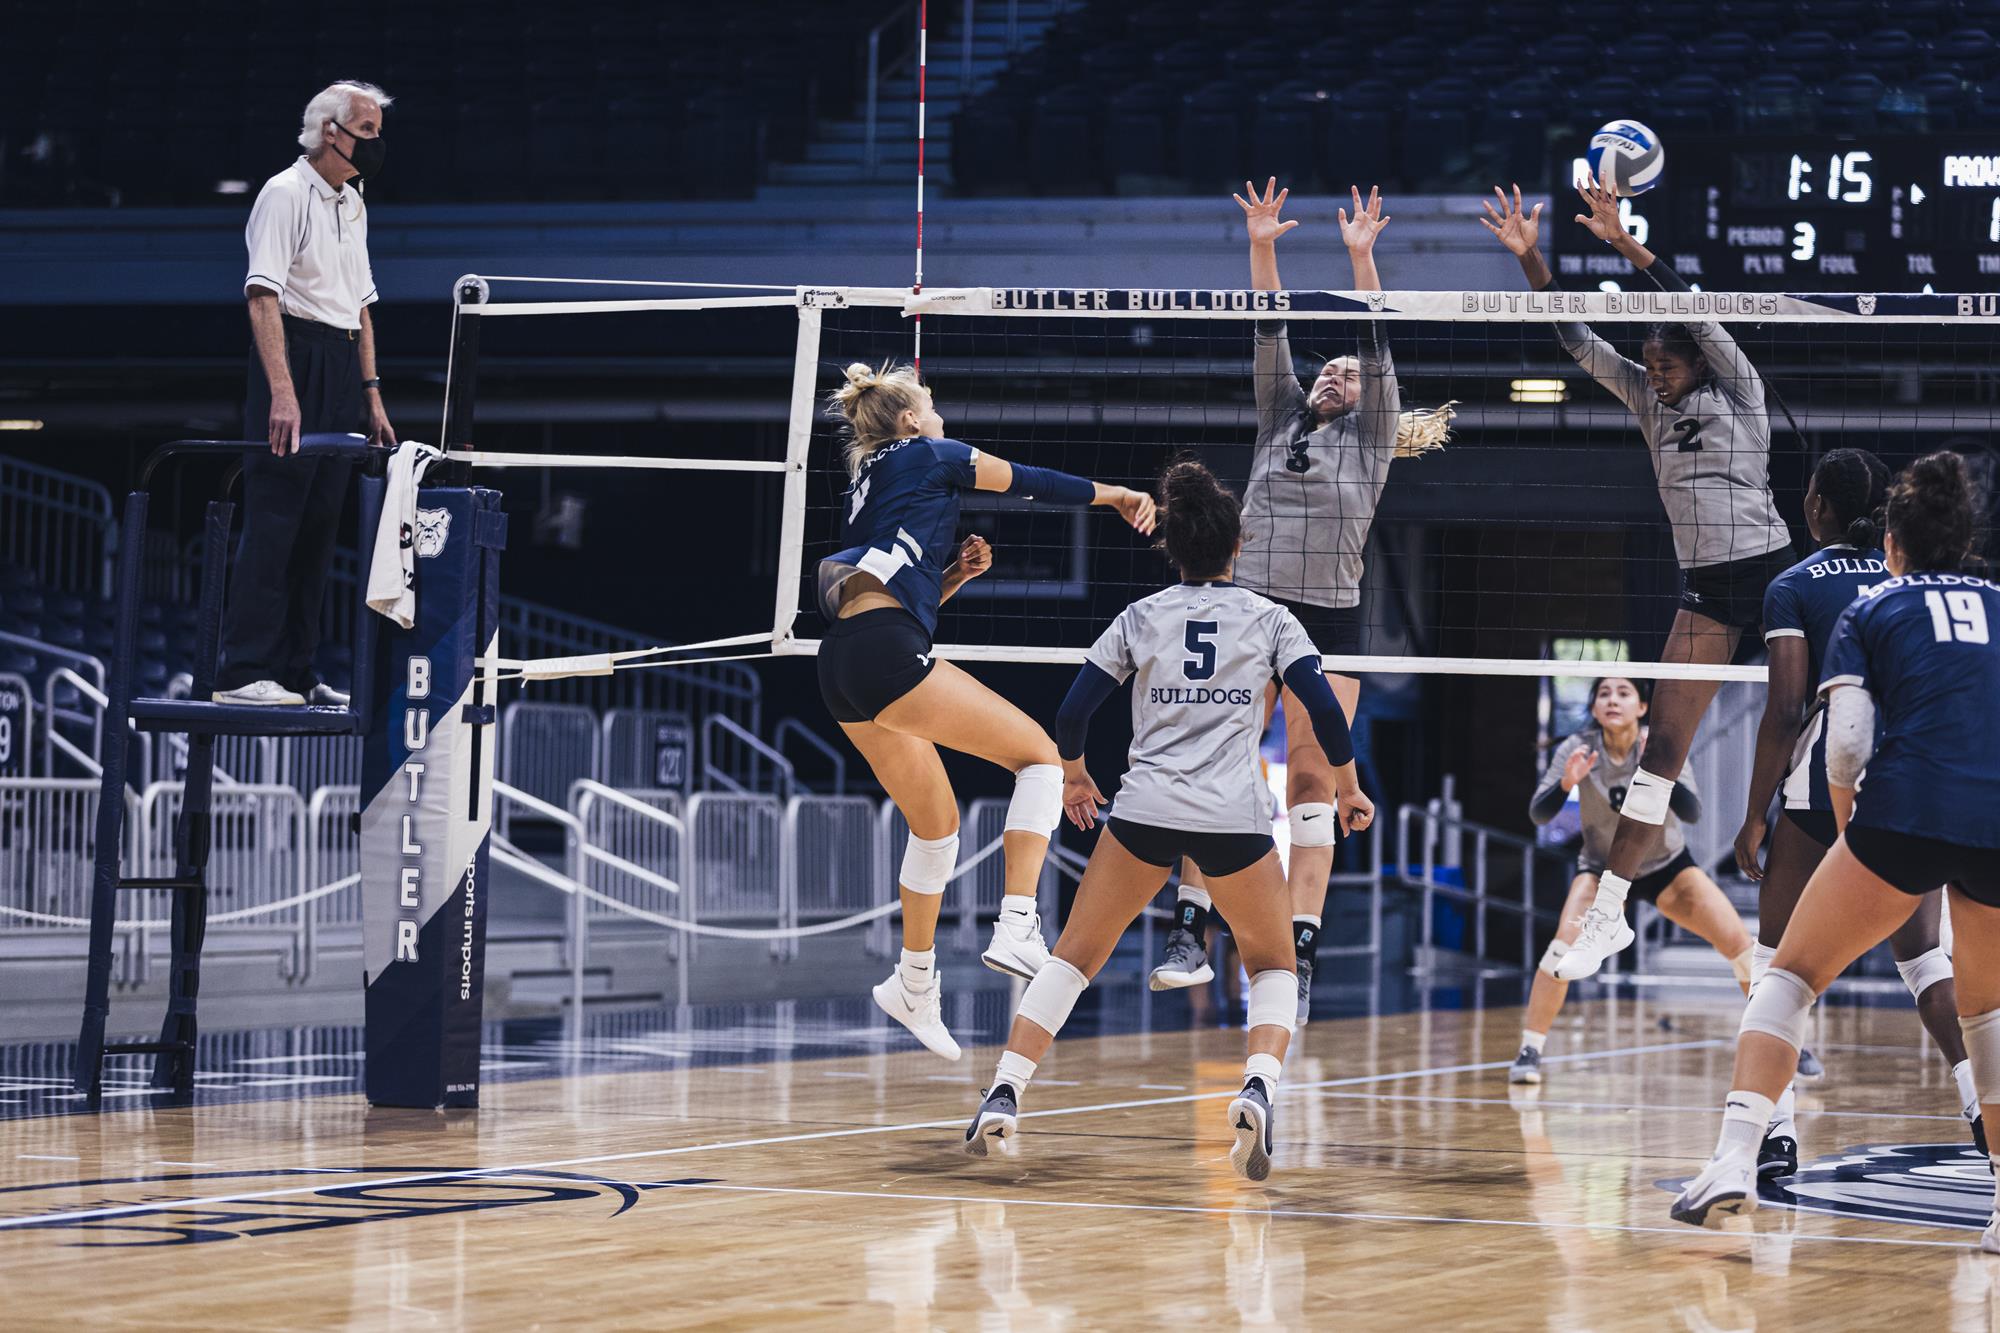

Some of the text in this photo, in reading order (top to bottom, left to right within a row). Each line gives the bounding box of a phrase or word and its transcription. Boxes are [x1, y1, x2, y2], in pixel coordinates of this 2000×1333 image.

[1788, 151, 1872, 202] 1:15
[1728, 227, 1785, 246] PERIOD
[1791, 221, 1816, 261] 3
[1744, 255, 1785, 274] PLYR
[1819, 255, 1858, 274] FOUL
[992, 289, 1291, 311] BUTLER BULLDOGS
[1462, 292, 1778, 315] BUTLER BULLDOGS
[1674, 418, 1703, 452] 2
[1925, 590, 1990, 645] 19
[1182, 619, 1219, 682] 5
[1151, 688, 1252, 704] BULLDOGS
[396, 655, 432, 963] BUTLER
[461, 854, 477, 1000] sports imports
